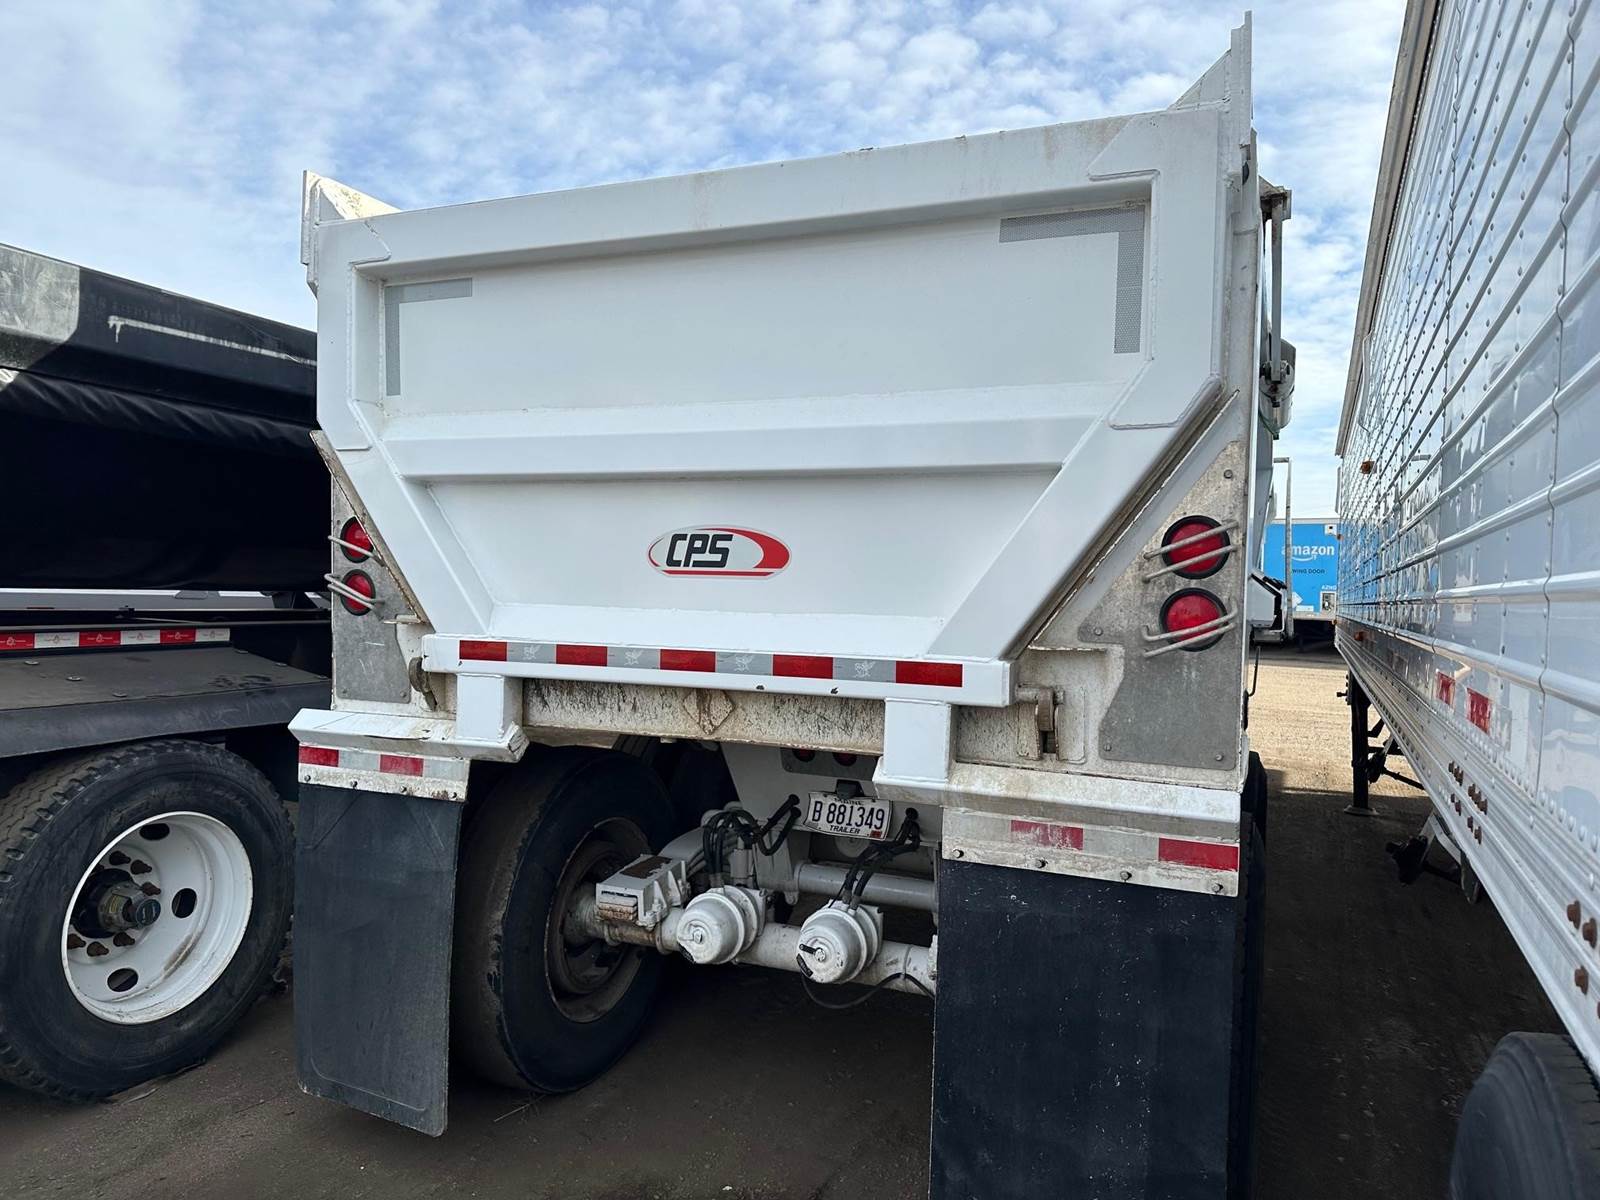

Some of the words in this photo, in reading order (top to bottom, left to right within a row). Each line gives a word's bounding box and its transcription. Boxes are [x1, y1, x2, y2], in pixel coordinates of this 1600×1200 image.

[666, 533, 734, 568] CPS
[811, 800, 823, 822] B
[826, 802, 885, 830] 881349
[829, 825, 861, 834] TRAILER
